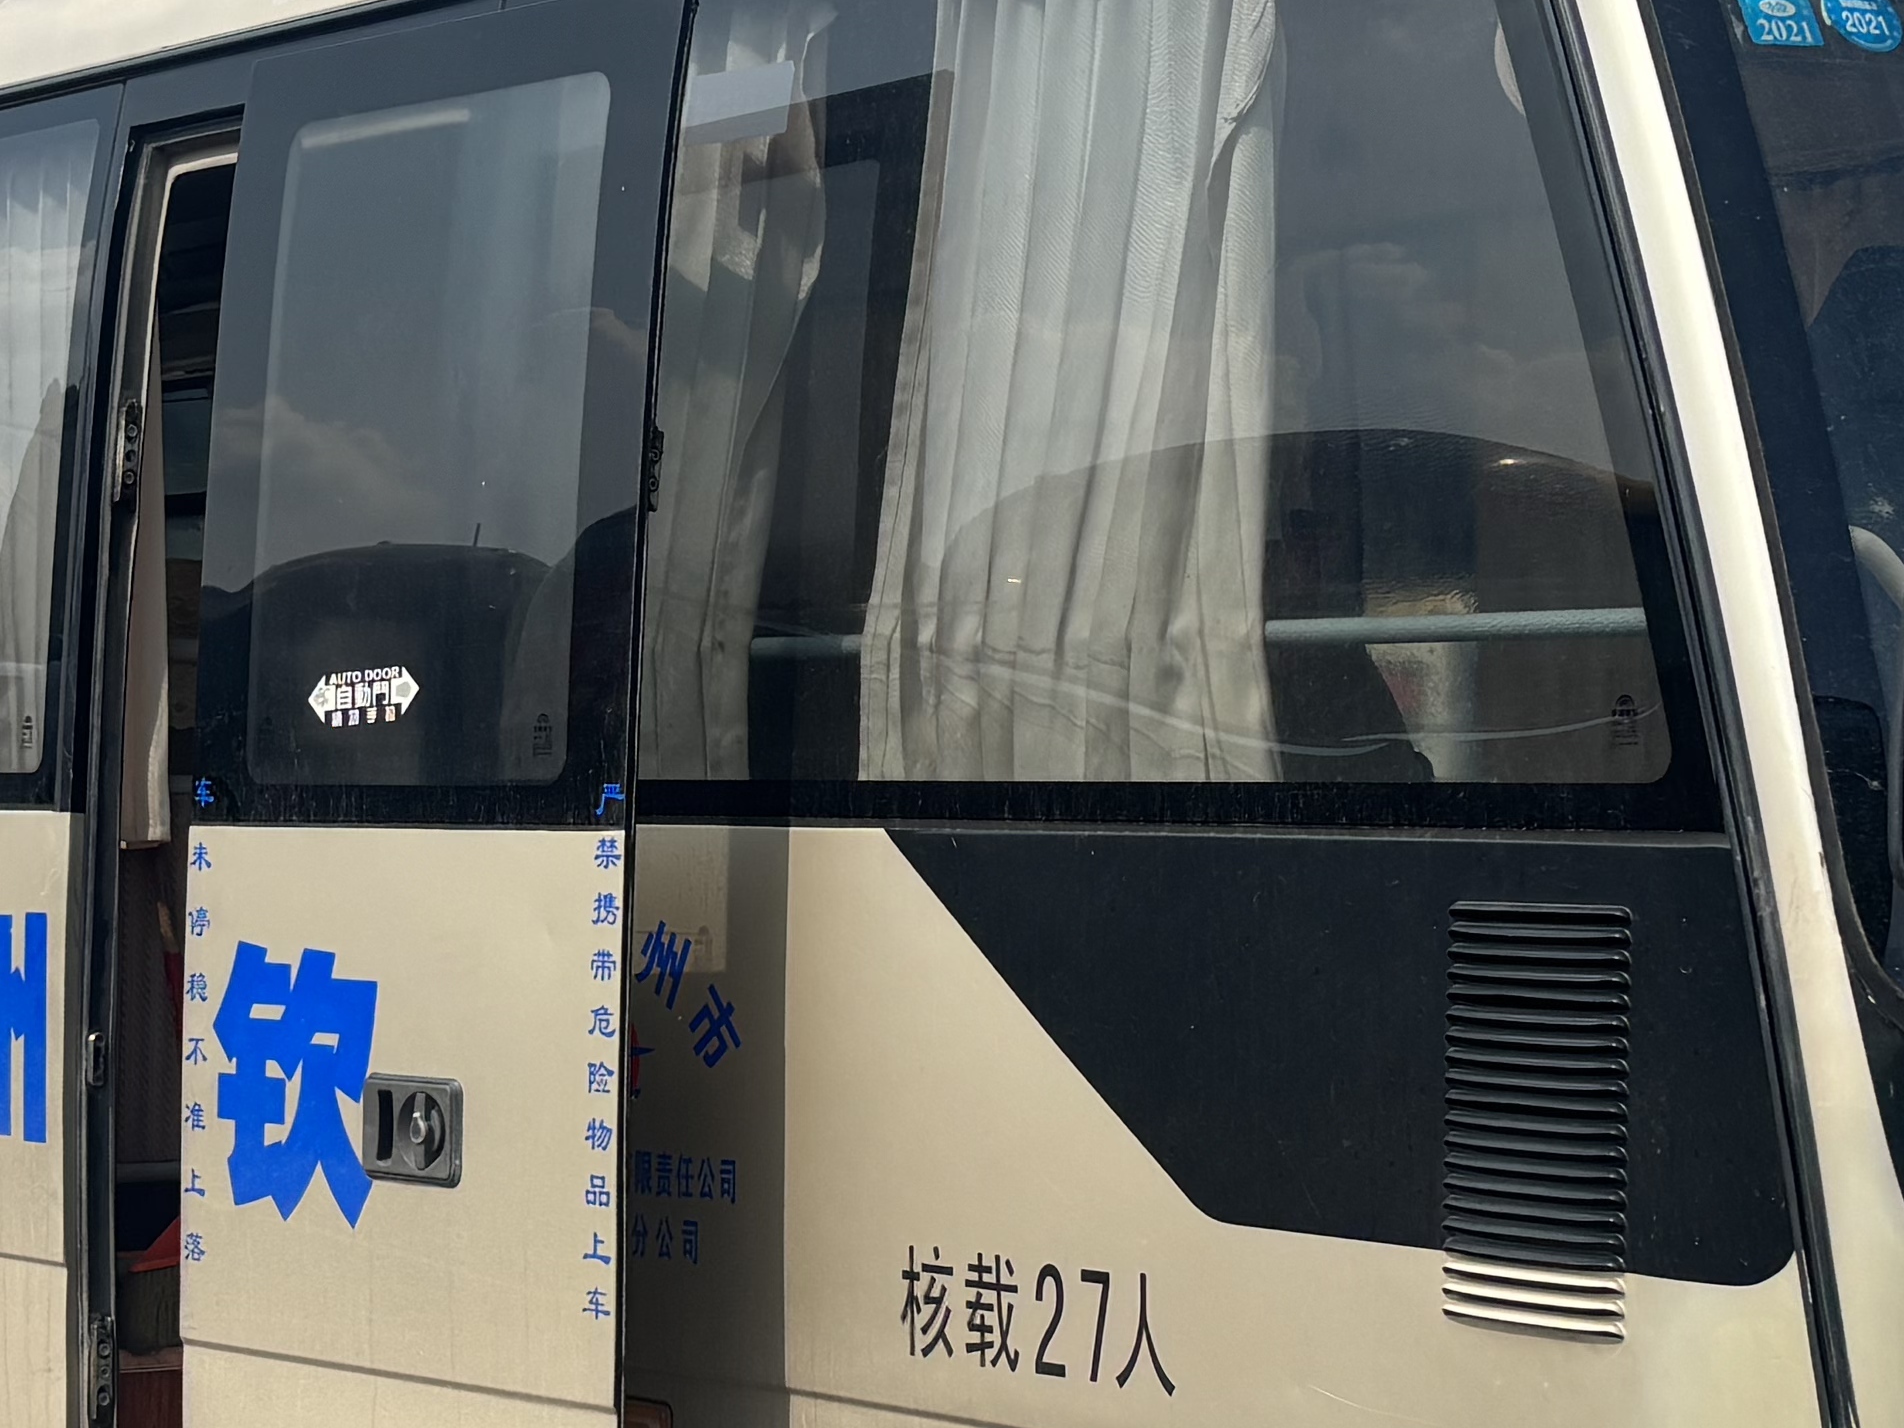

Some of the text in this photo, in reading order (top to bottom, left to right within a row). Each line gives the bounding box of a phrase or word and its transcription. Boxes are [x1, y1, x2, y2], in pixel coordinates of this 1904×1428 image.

[1757, 18, 1814, 43] 2021
[1841, 11, 1891, 37] 2021
[329, 666, 400, 686] AUTO DOOR
[628, 1149, 739, 1205] 限责任公司
[900, 1244, 1176, 1398] 核载27人
